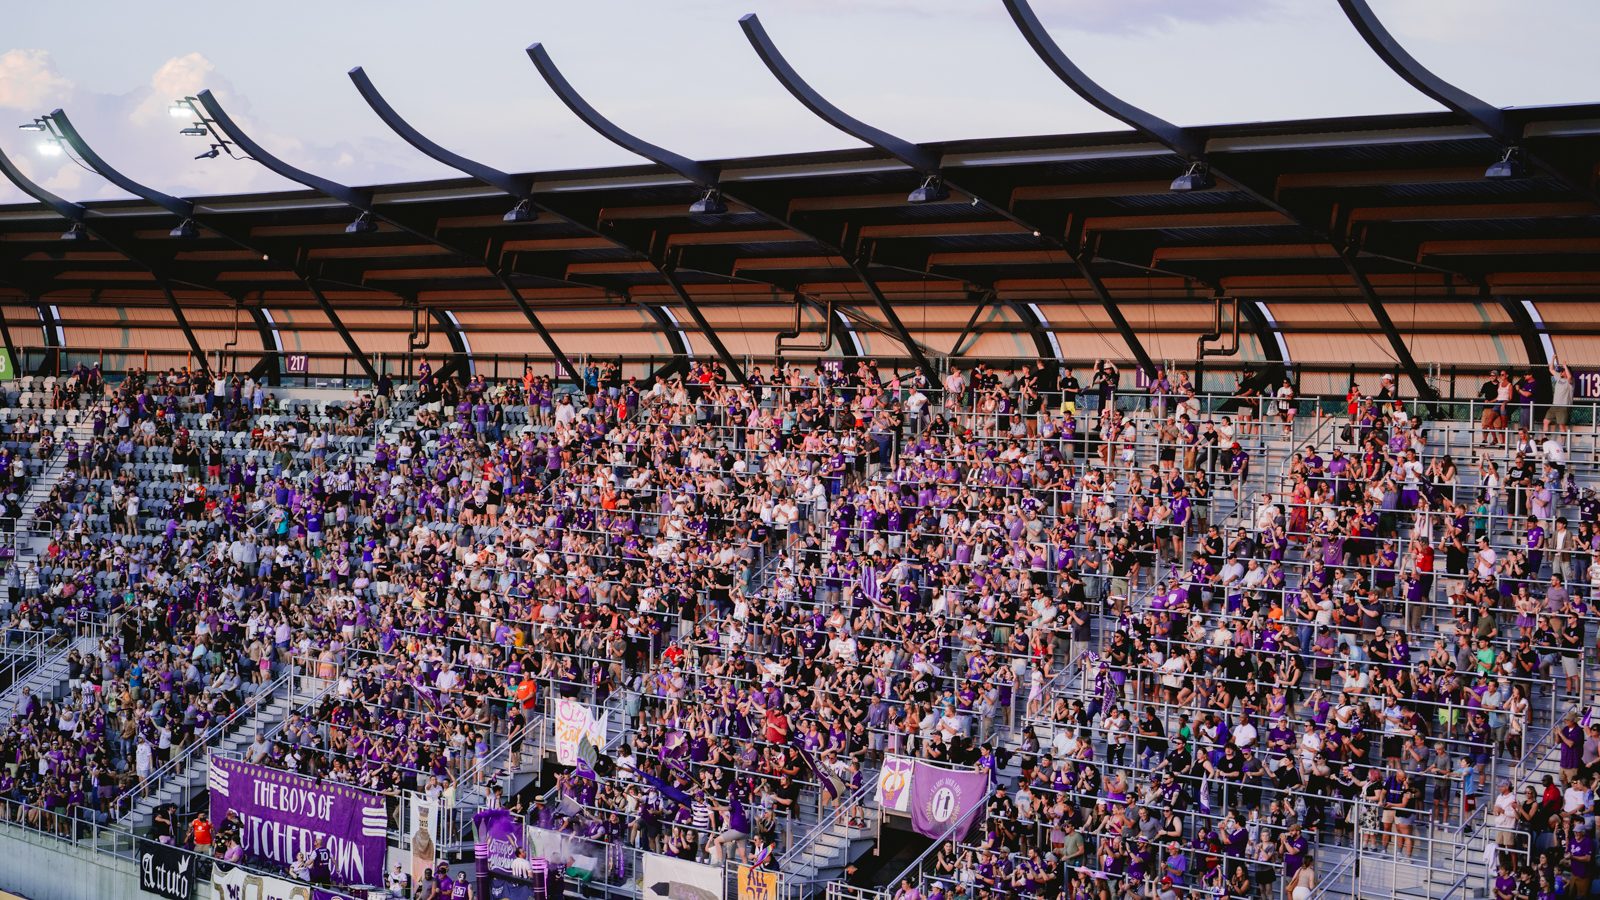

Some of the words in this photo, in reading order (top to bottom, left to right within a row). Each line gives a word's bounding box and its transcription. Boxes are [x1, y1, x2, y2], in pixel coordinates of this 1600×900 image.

[290, 356, 305, 371] 217
[1578, 373, 1600, 397] 113
[254, 779, 279, 810] THE
[279, 786, 317, 818] BOYS
[318, 795, 335, 821] OF
[228, 808, 365, 885] UTCHEROWN
[320, 852, 329, 861] 10
[142, 853, 188, 899] Arturo
[747, 869, 767, 888] ALL
